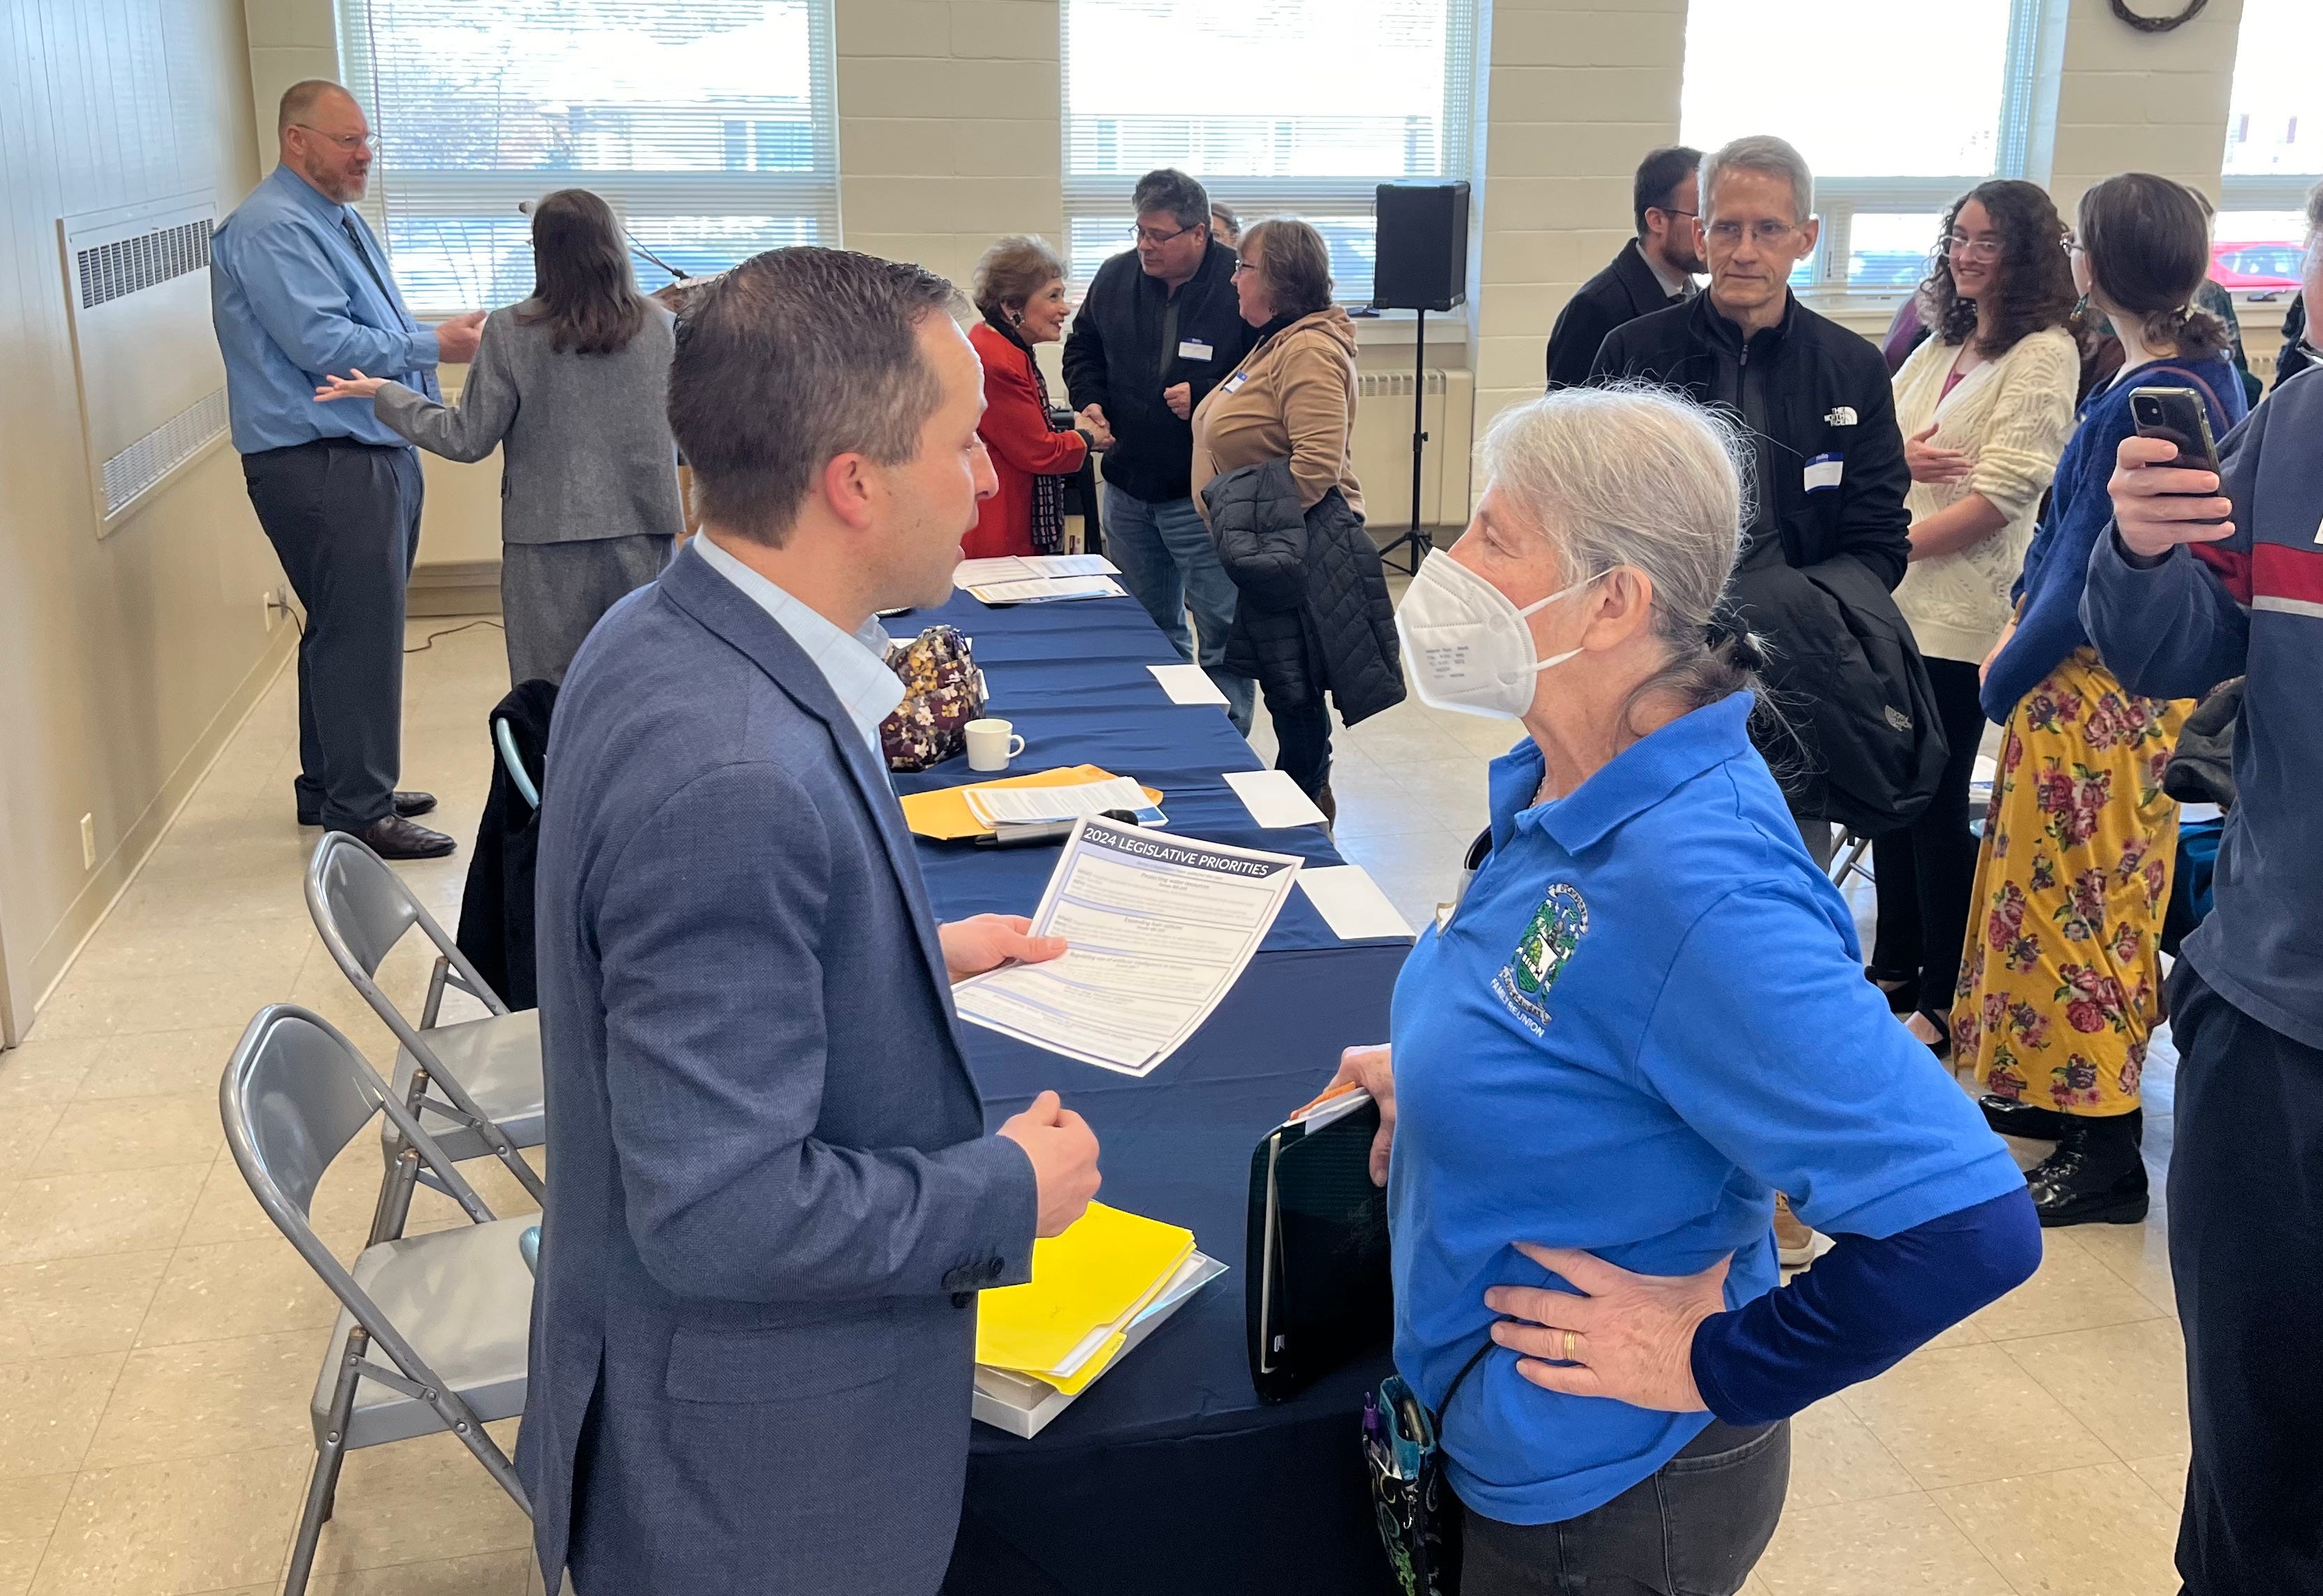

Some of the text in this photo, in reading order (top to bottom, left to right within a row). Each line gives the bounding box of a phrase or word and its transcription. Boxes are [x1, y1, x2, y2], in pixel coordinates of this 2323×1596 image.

[1084, 827, 1117, 847] 2024
[1119, 837, 1198, 865] LEGISLATIVE
[1198, 855, 1269, 876] PRIORITIES
[1490, 977, 1510, 1004] FAMILY
[1506, 1000, 1545, 1038] REUNION
